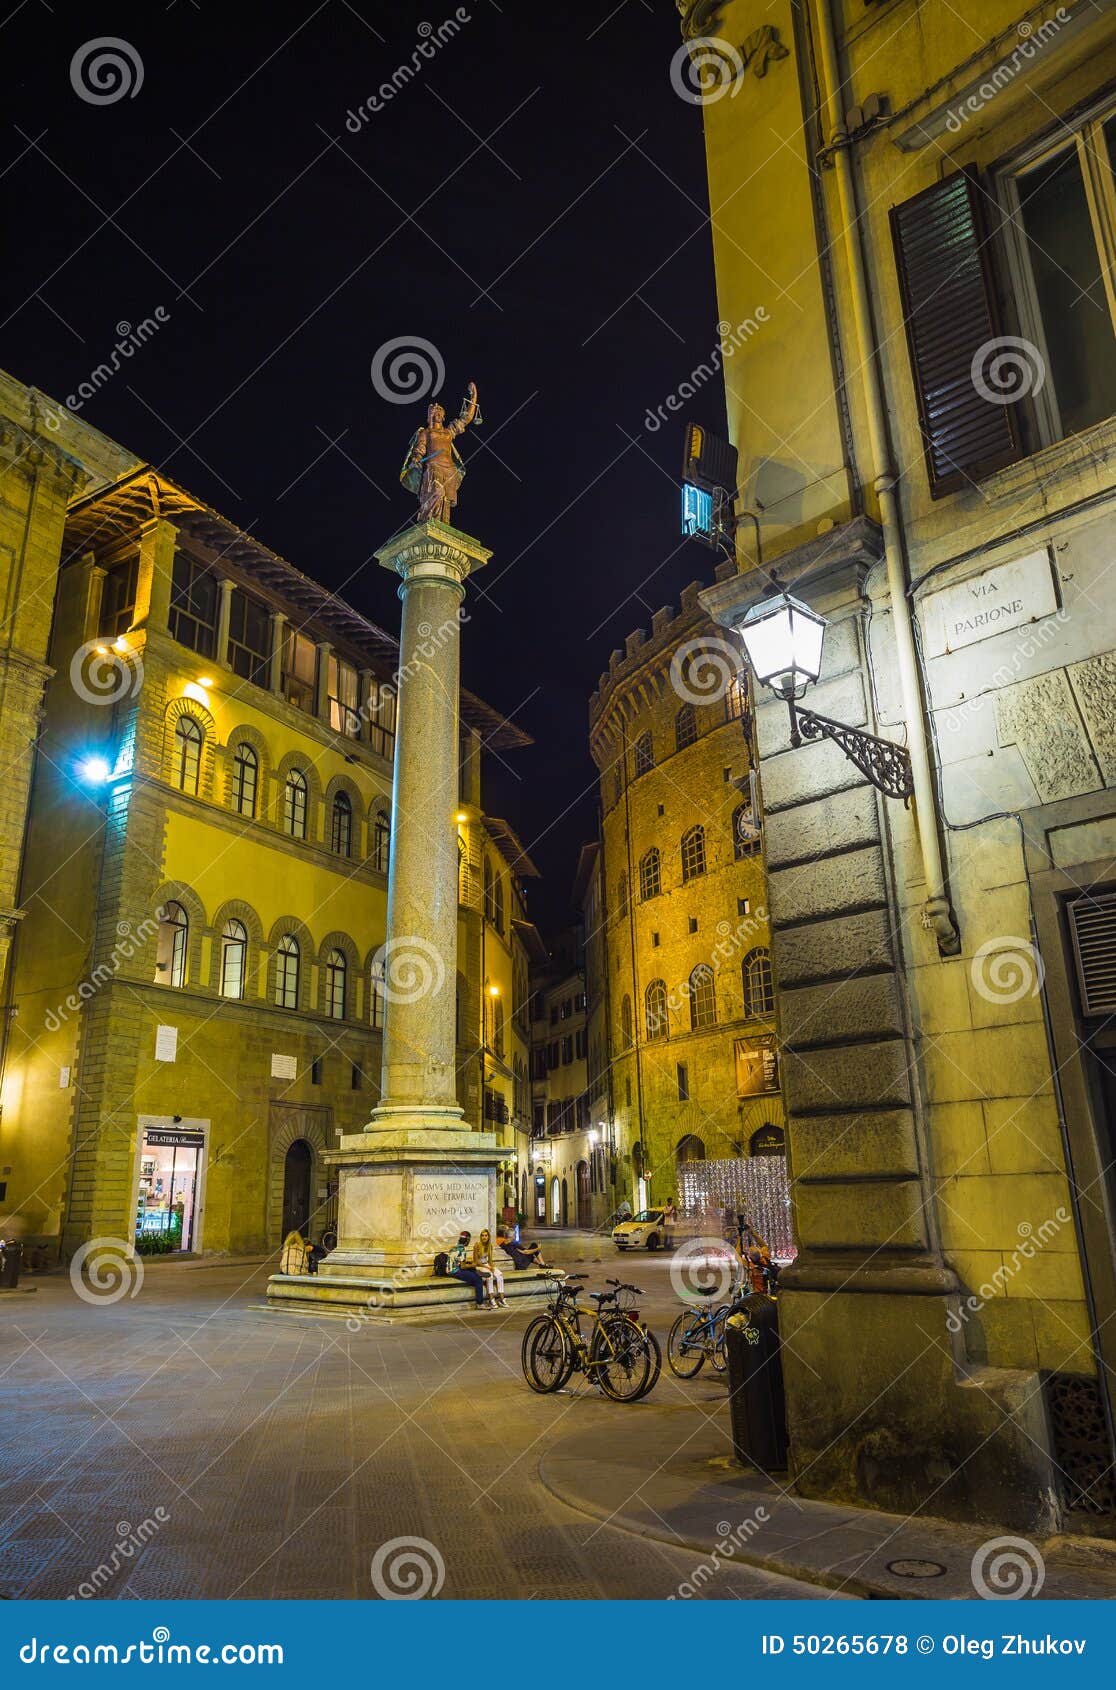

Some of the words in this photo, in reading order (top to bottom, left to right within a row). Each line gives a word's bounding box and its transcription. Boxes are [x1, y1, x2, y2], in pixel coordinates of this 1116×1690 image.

[972, 583, 998, 598] VIA
[954, 600, 1024, 635] PARIONE
[148, 1135, 179, 1144] GELATERIA
